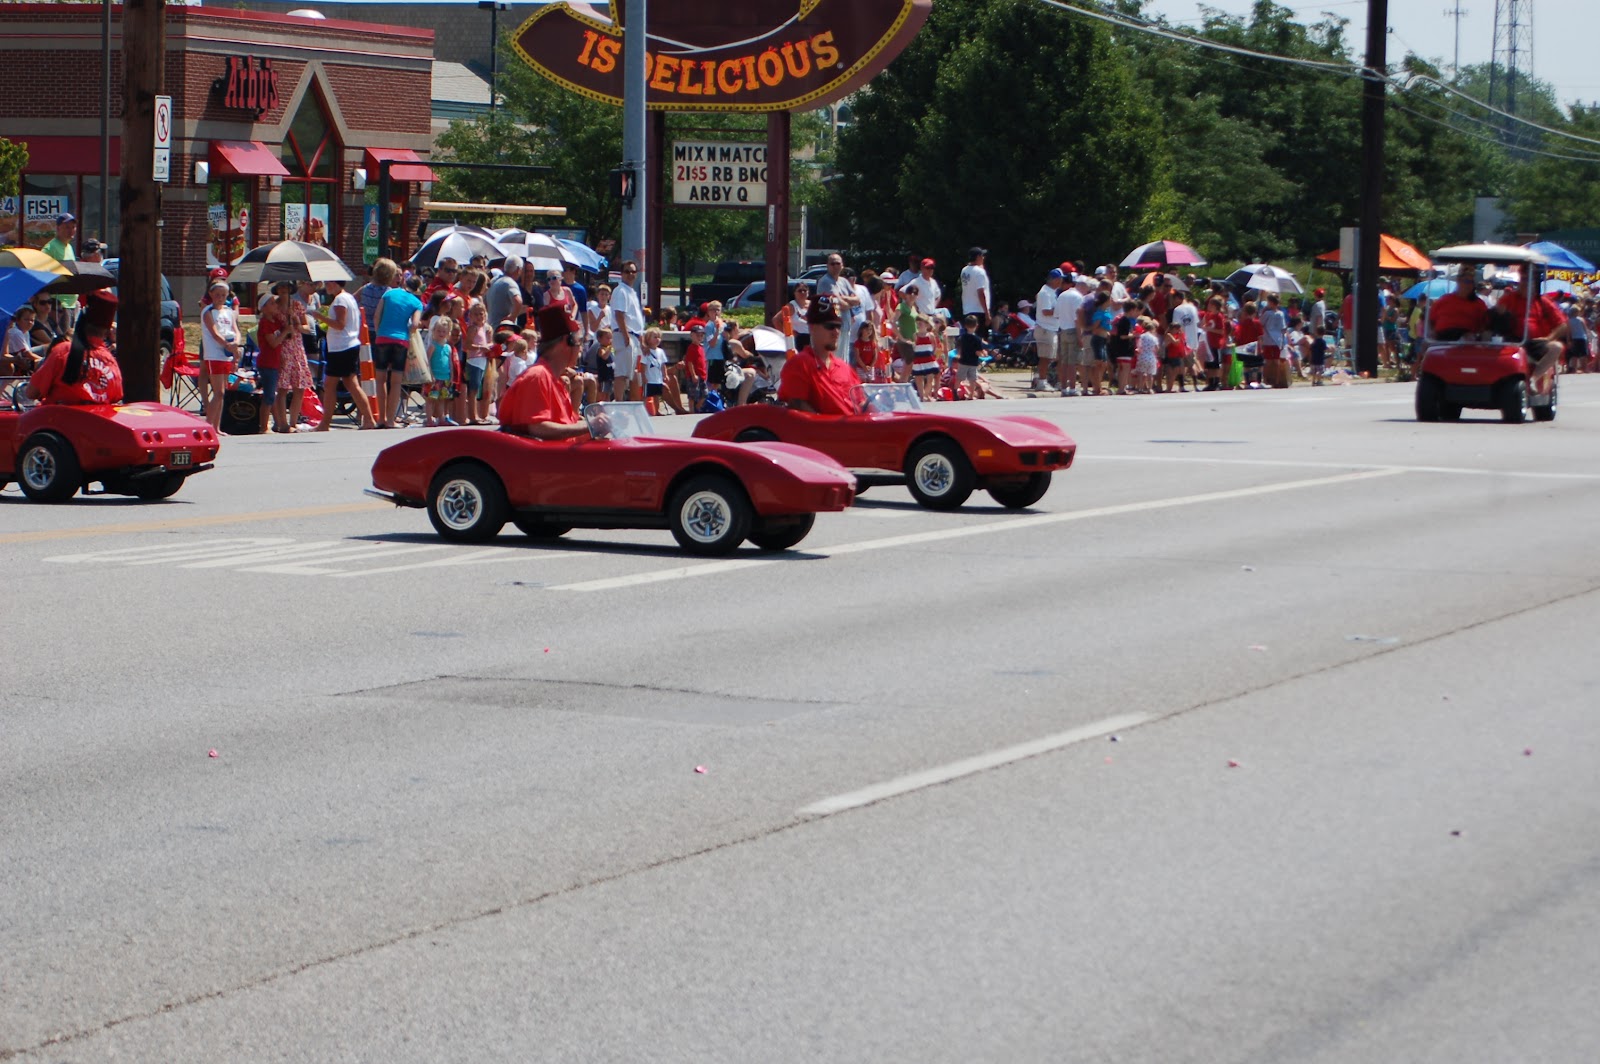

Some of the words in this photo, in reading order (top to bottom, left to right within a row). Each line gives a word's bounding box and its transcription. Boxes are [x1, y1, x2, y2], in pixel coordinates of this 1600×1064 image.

[577, 29, 622, 73] IS
[225, 55, 278, 121] Arby's
[674, 146, 704, 161] MIX
[707, 146, 716, 161] N
[712, 166, 733, 182] RB
[689, 185, 732, 201] ARBY
[736, 186, 748, 202] Q
[27, 199, 60, 214] FISH
[173, 453, 190, 465] JEFF
